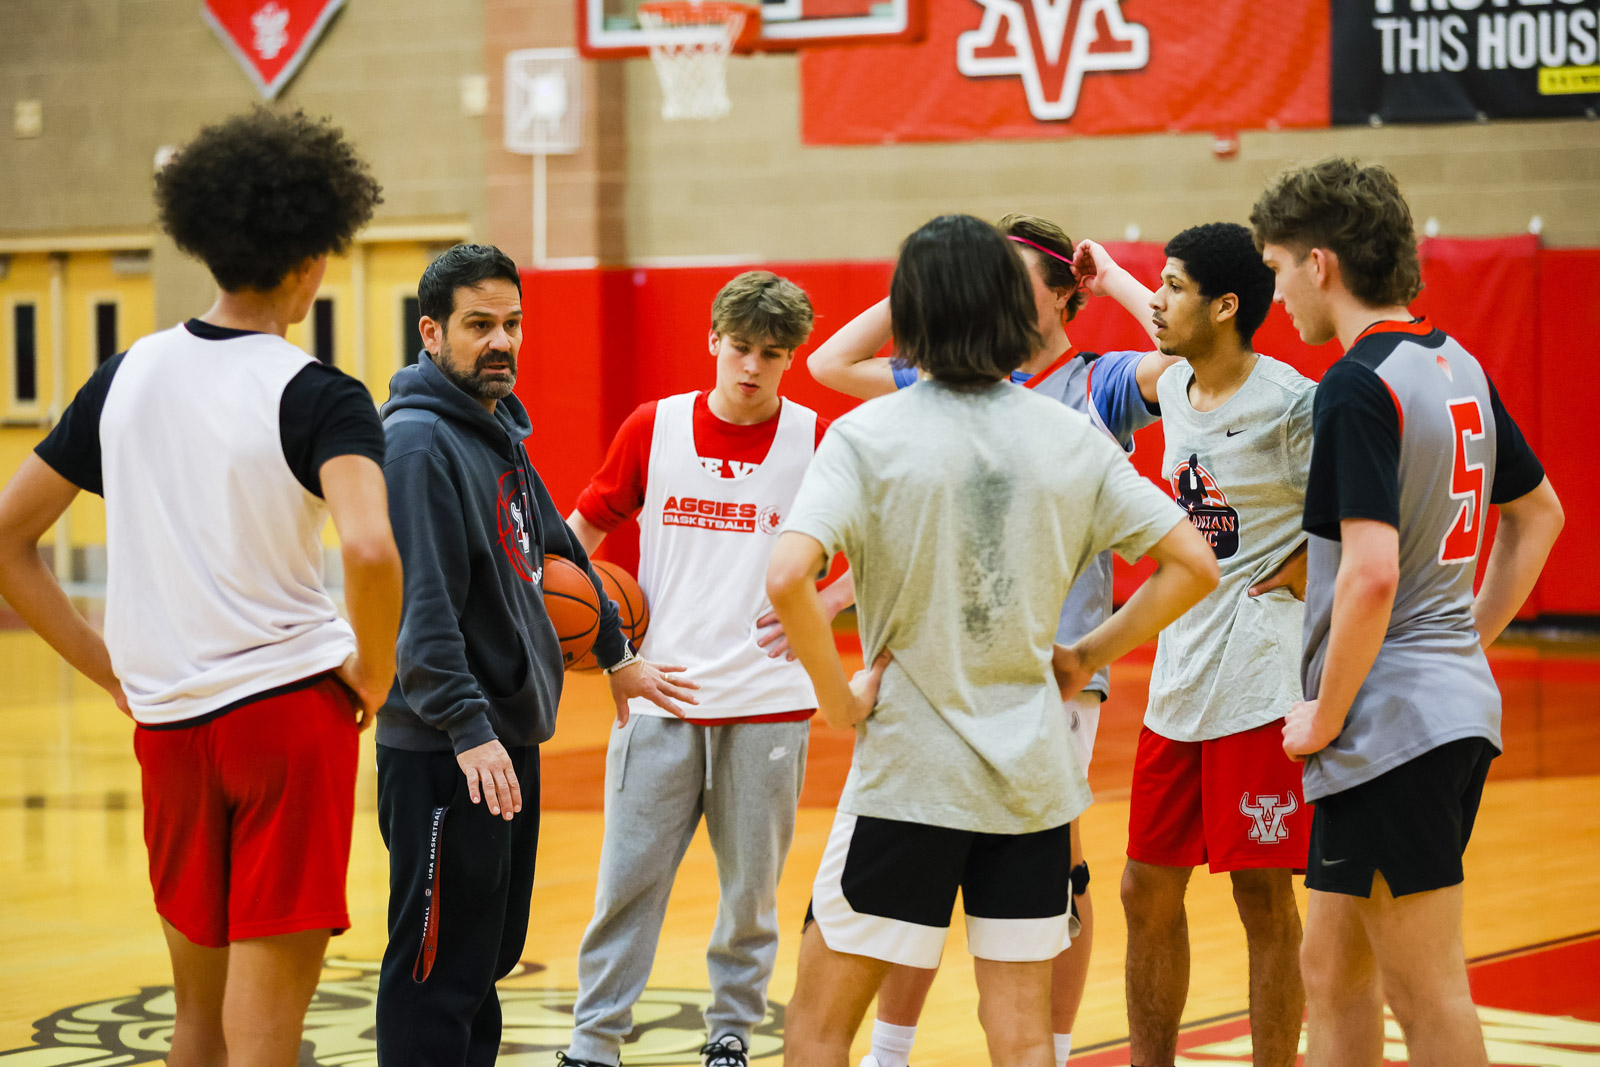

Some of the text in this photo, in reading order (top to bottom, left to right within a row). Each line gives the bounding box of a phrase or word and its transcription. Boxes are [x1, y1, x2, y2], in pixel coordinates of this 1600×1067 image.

[1372, 9, 1600, 74] THIS HOUS
[1438, 396, 1485, 565] 5
[663, 514, 754, 531] BASKETBALL
[664, 496, 757, 518] AGGIES
[1188, 515, 1234, 531] ANIAN
[430, 807, 444, 860] BASKETBALL
